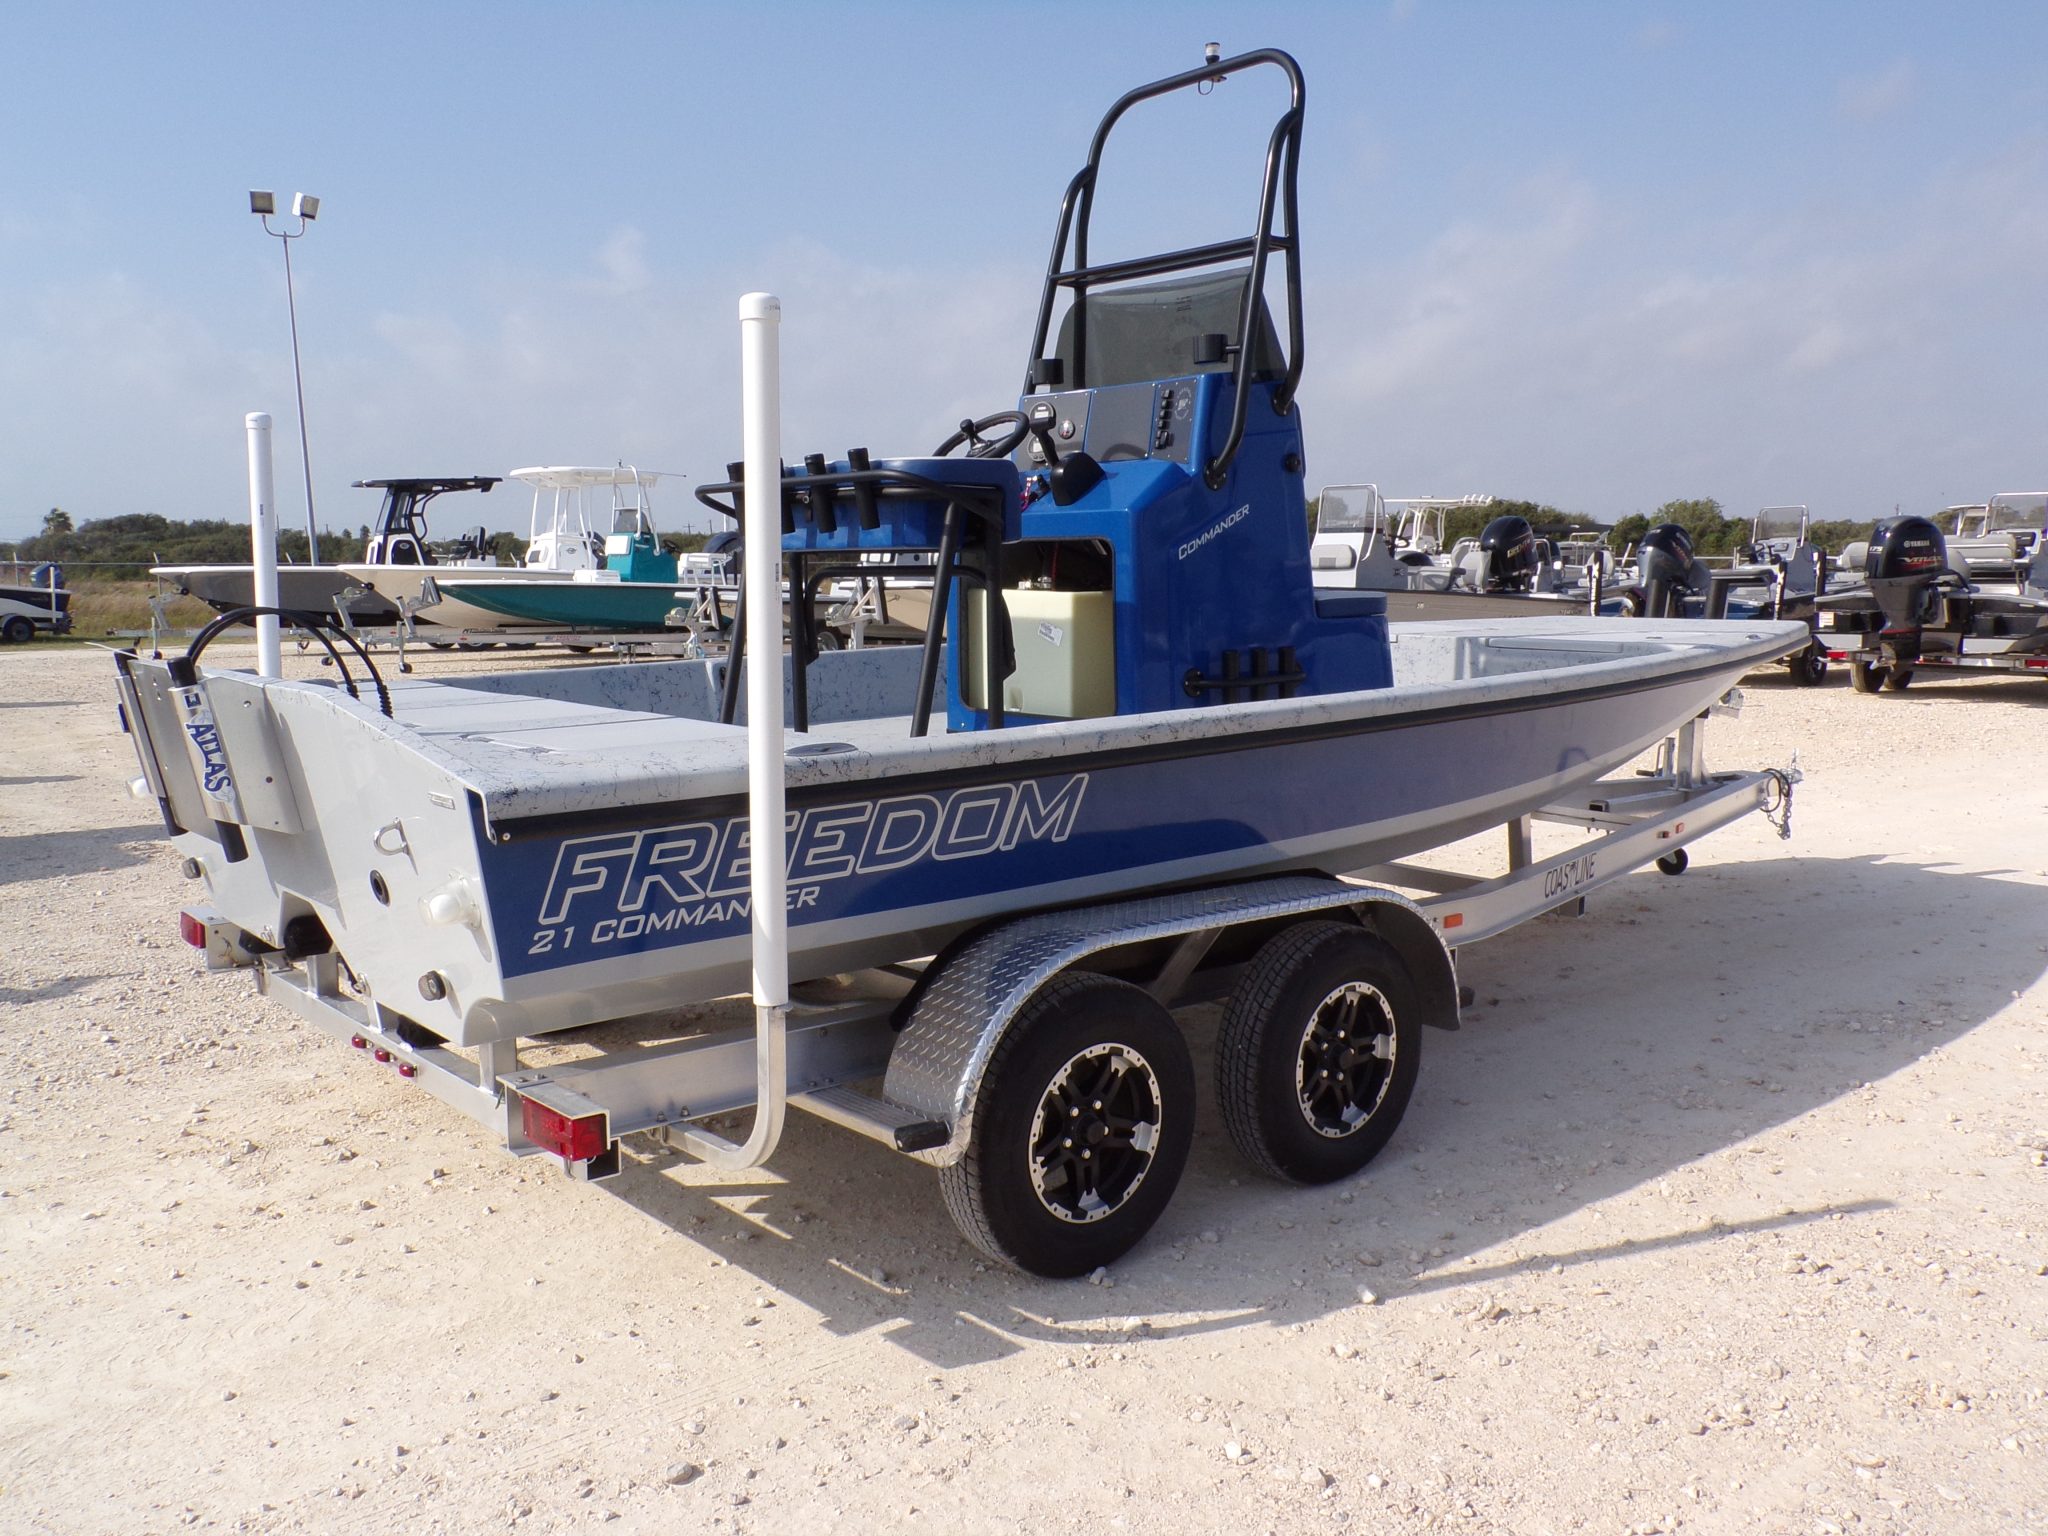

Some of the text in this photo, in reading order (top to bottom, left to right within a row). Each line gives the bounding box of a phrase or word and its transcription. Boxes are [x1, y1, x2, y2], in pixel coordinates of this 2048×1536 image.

[1178, 503, 1250, 561] COMMANDER
[184, 722, 233, 793] ATLAS
[538, 772, 1089, 926] FREEDOM
[527, 885, 821, 956] 21 COMMANER
